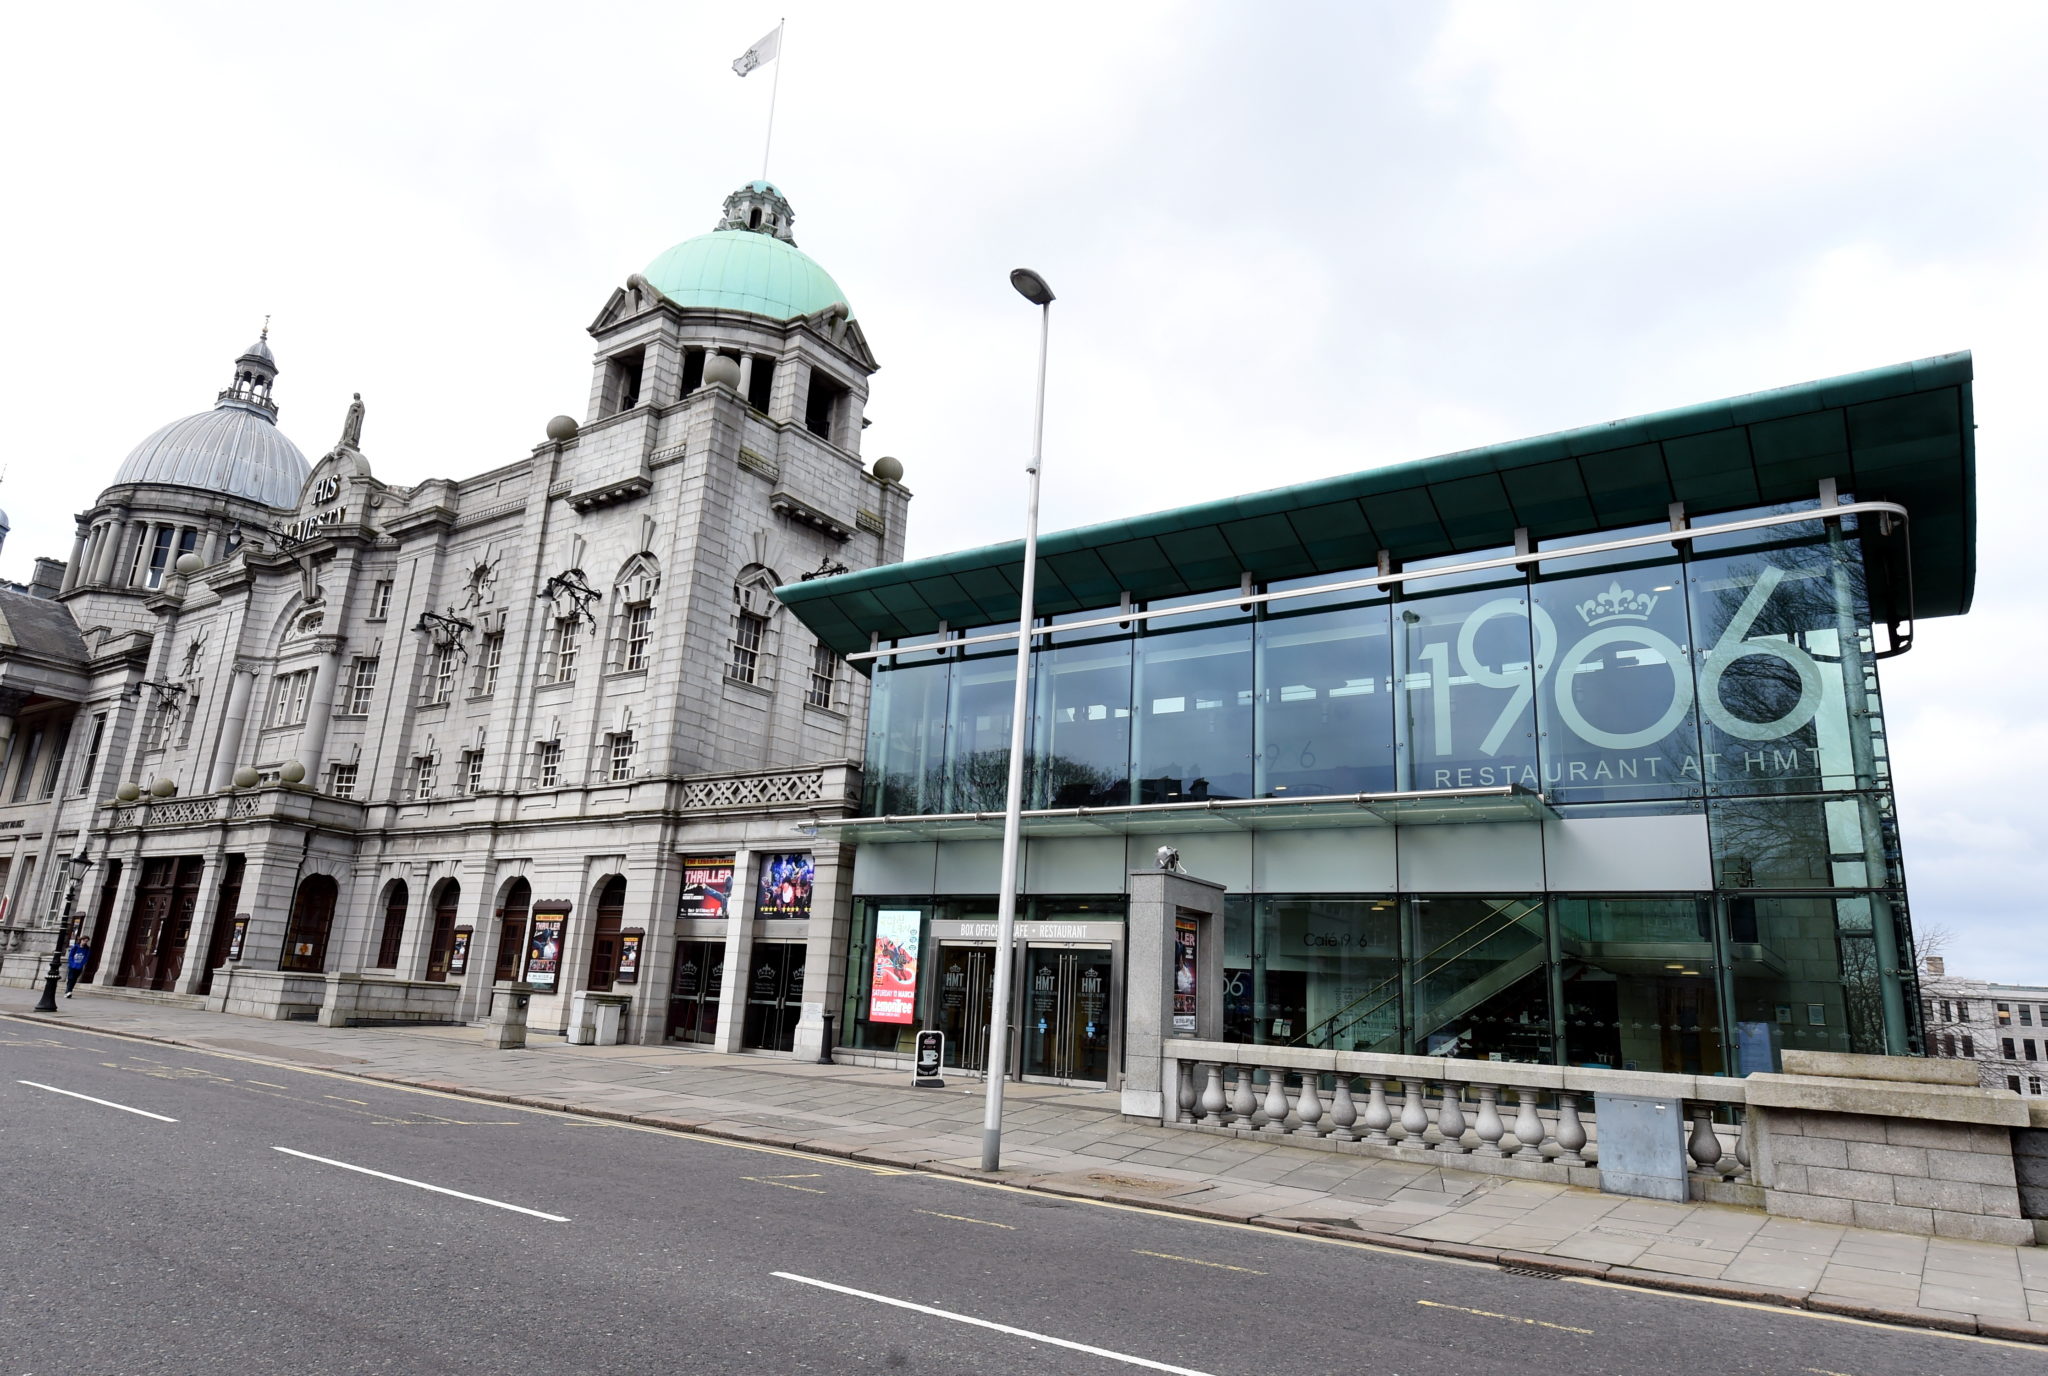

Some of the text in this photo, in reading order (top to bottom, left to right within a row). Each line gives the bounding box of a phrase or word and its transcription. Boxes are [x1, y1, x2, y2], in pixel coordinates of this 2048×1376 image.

[311, 474, 338, 505] HIS
[280, 505, 347, 546] MAJESTY
[1418, 566, 1823, 757] 1906
[1435, 747, 1824, 788] RESTAURANT AT HMT
[684, 869, 732, 883] THRILLER
[960, 923, 974, 936] BOX
[1013, 925, 1029, 938] AFE
[1039, 925, 1088, 938] RESTAURANT
[1340, 932, 1368, 948] 196
[946, 973, 965, 987] HMT
[1035, 975, 1055, 991] HMT
[1081, 977, 1102, 993] HMT
